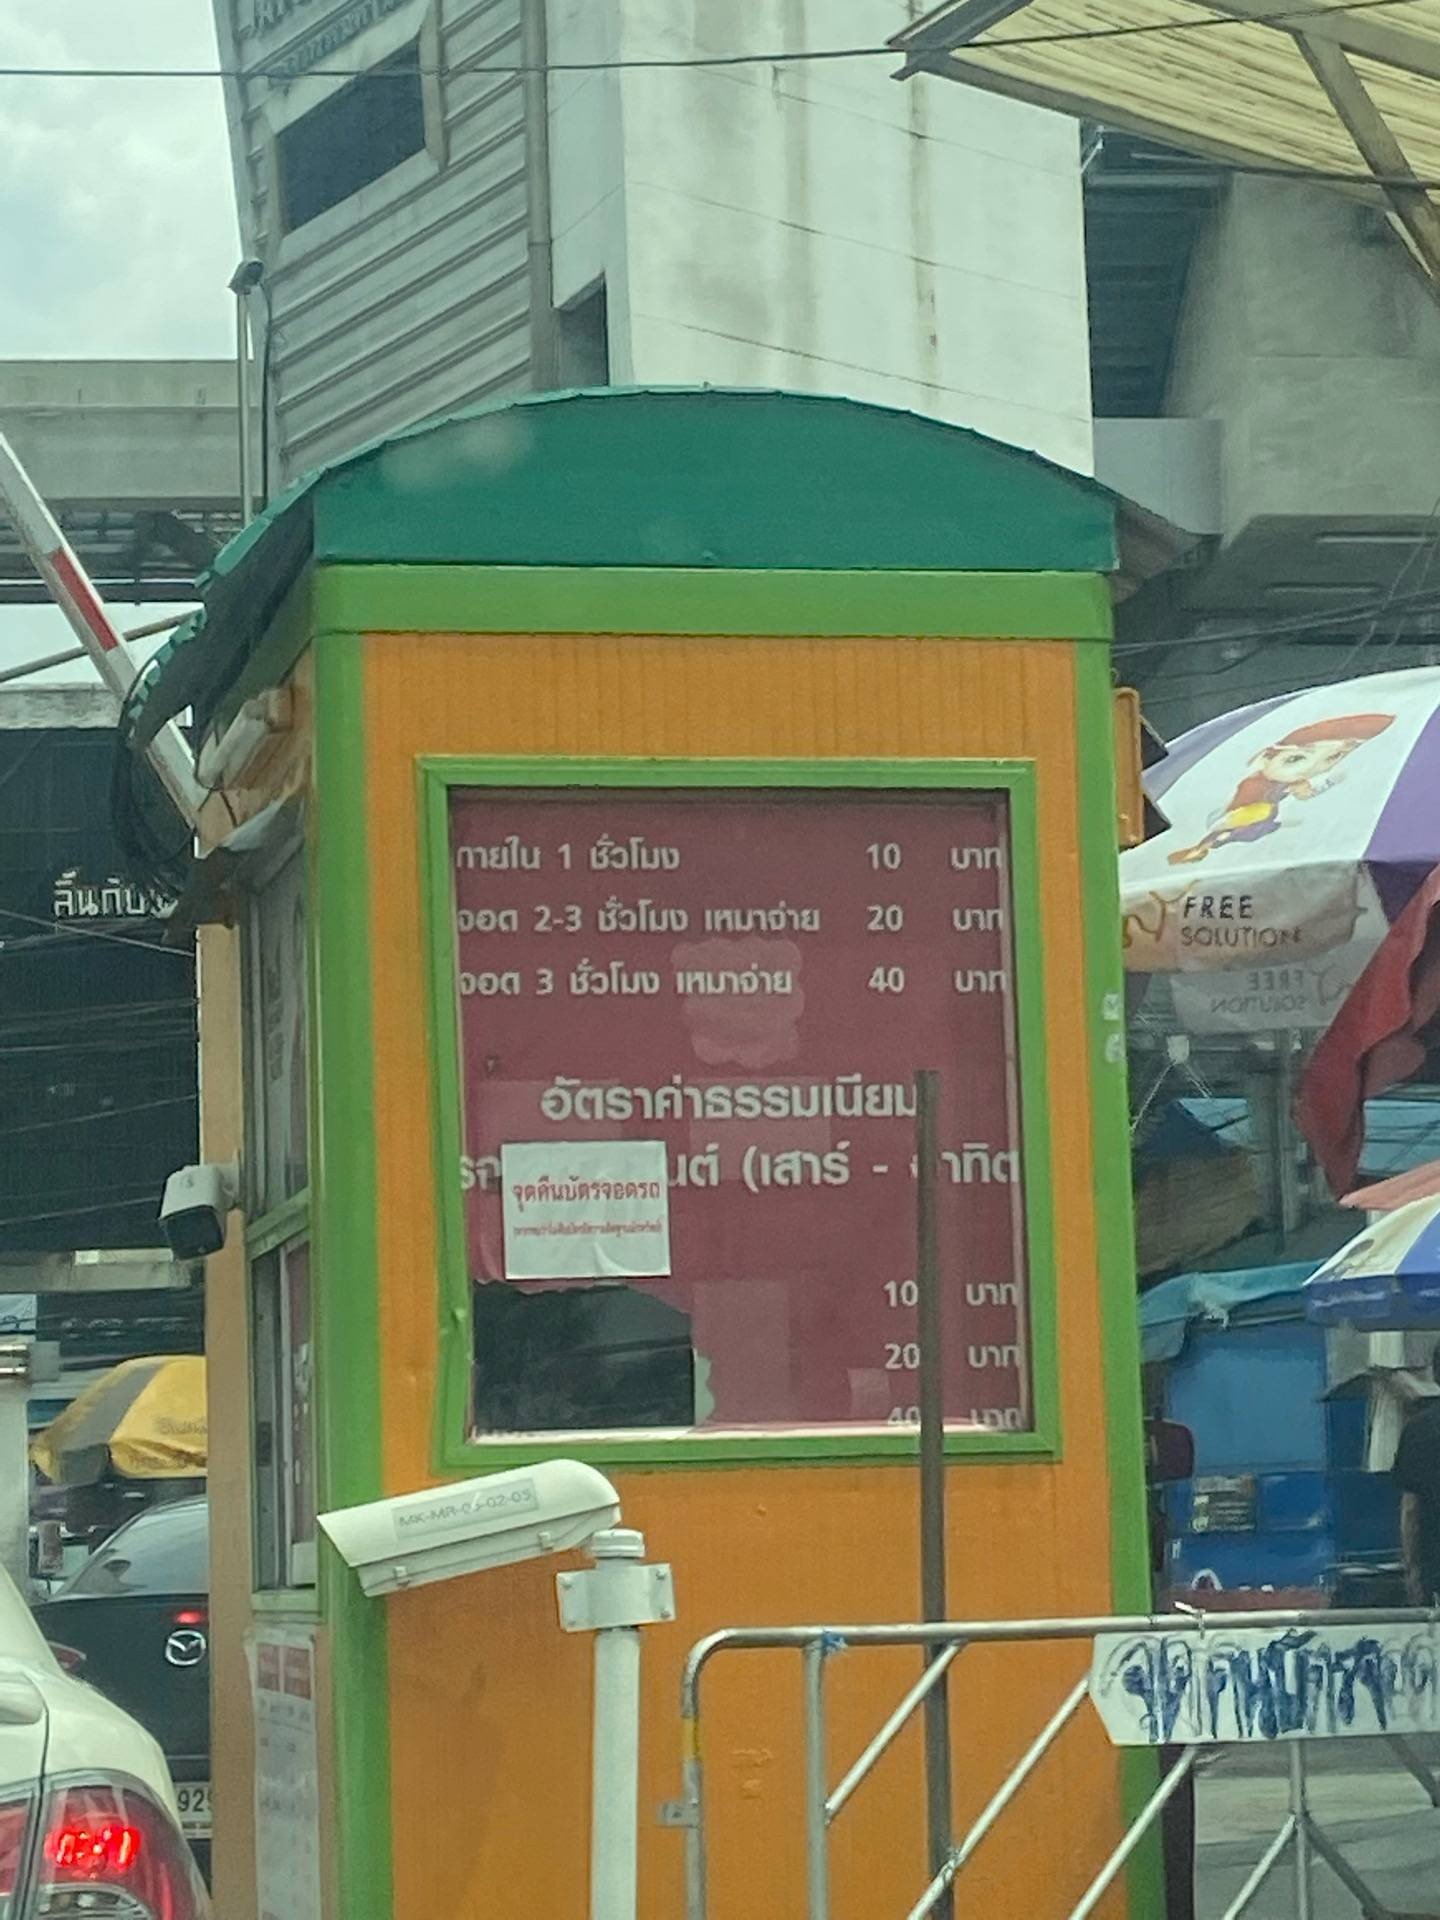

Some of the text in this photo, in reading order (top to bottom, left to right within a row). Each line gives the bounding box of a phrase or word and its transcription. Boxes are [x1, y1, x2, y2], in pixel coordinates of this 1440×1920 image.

[558, 843, 571, 869] 1
[590, 833, 680, 869] ชั่วโมง
[867, 843, 901, 869] 10
[457, 908, 517, 932] จอด
[534, 905, 582, 932] 2-3
[598, 896, 688, 932] ชั่วโมง
[705, 900, 820, 932] เหมาจ่าย
[867, 905, 903, 931] 20
[1183, 895, 1253, 920] FREE
[1180, 926, 1301, 948] SOLUTION
[460, 972, 520, 995] จอด
[536, 968, 553, 995] 3
[570, 958, 660, 995] ชั่วโมง
[677, 963, 792, 994] เหมาจ่าย
[869, 967, 905, 993] 40
[541, 1073, 917, 1120] อัตราค่าธรรมเนียม
[884, 1280, 918, 1307] 10
[884, 1343, 920, 1369] 20
[178, 1789, 211, 1812] 92
